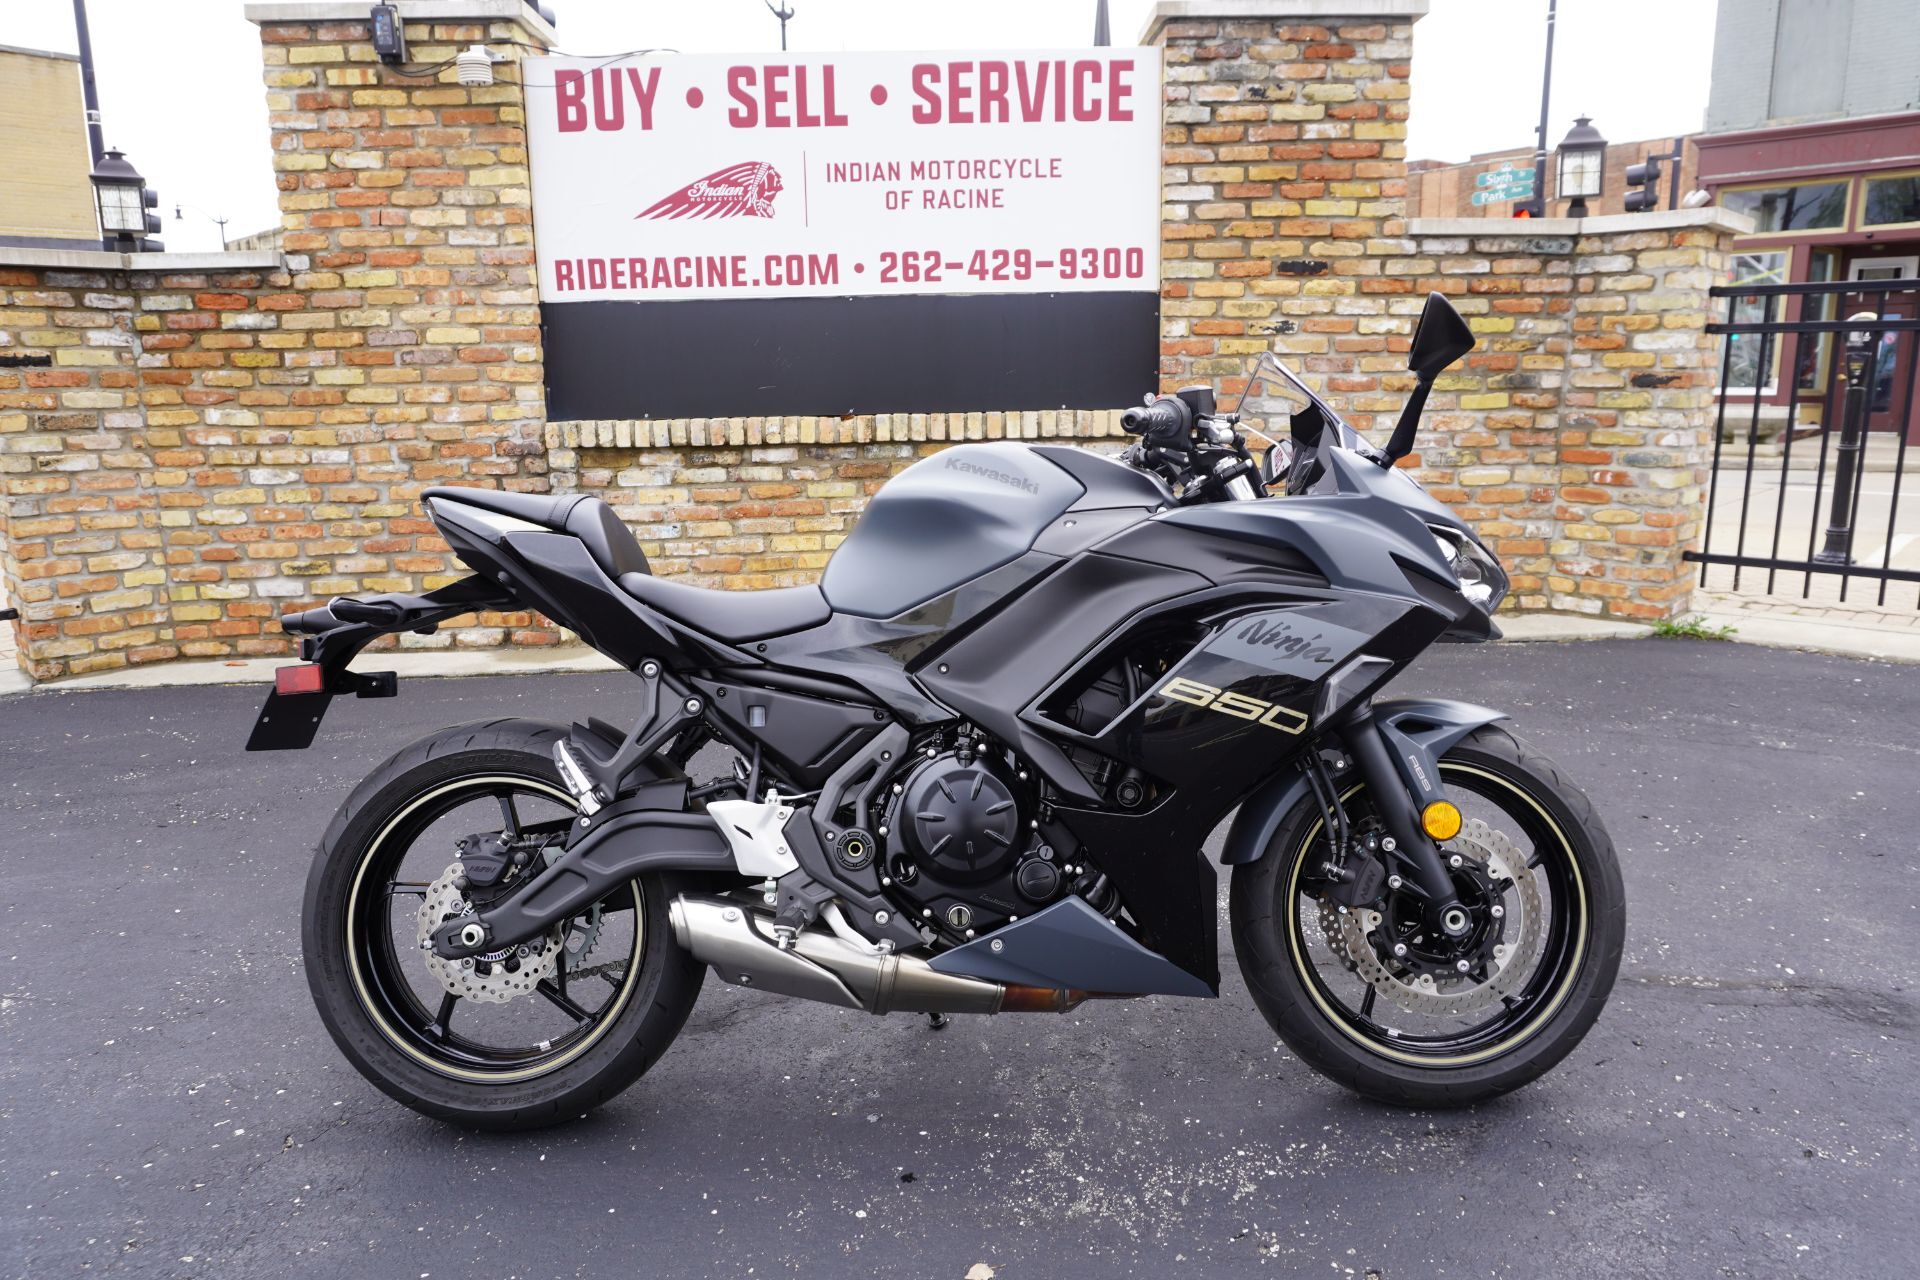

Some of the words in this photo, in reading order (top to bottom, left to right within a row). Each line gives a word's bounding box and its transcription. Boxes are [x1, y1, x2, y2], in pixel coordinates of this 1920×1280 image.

[556, 67, 661, 132] BUY
[727, 65, 848, 128] SELL
[912, 60, 1134, 124] SERVICE
[688, 181, 744, 197] Indian
[826, 161, 902, 183] INDIAN
[911, 158, 1062, 180] MOTORCYCLE
[886, 190, 911, 210] OF
[924, 188, 1005, 209] RACINE
[1481, 190, 1506, 203] Park
[555, 253, 838, 292] RIDERACINE.COM
[880, 247, 1144, 285] 262-429-9300
[945, 457, 1040, 495] Kawasaki
[1237, 619, 1334, 663] Ninja
[1159, 677, 1309, 735] 650
[1408, 754, 1431, 792] ABS
